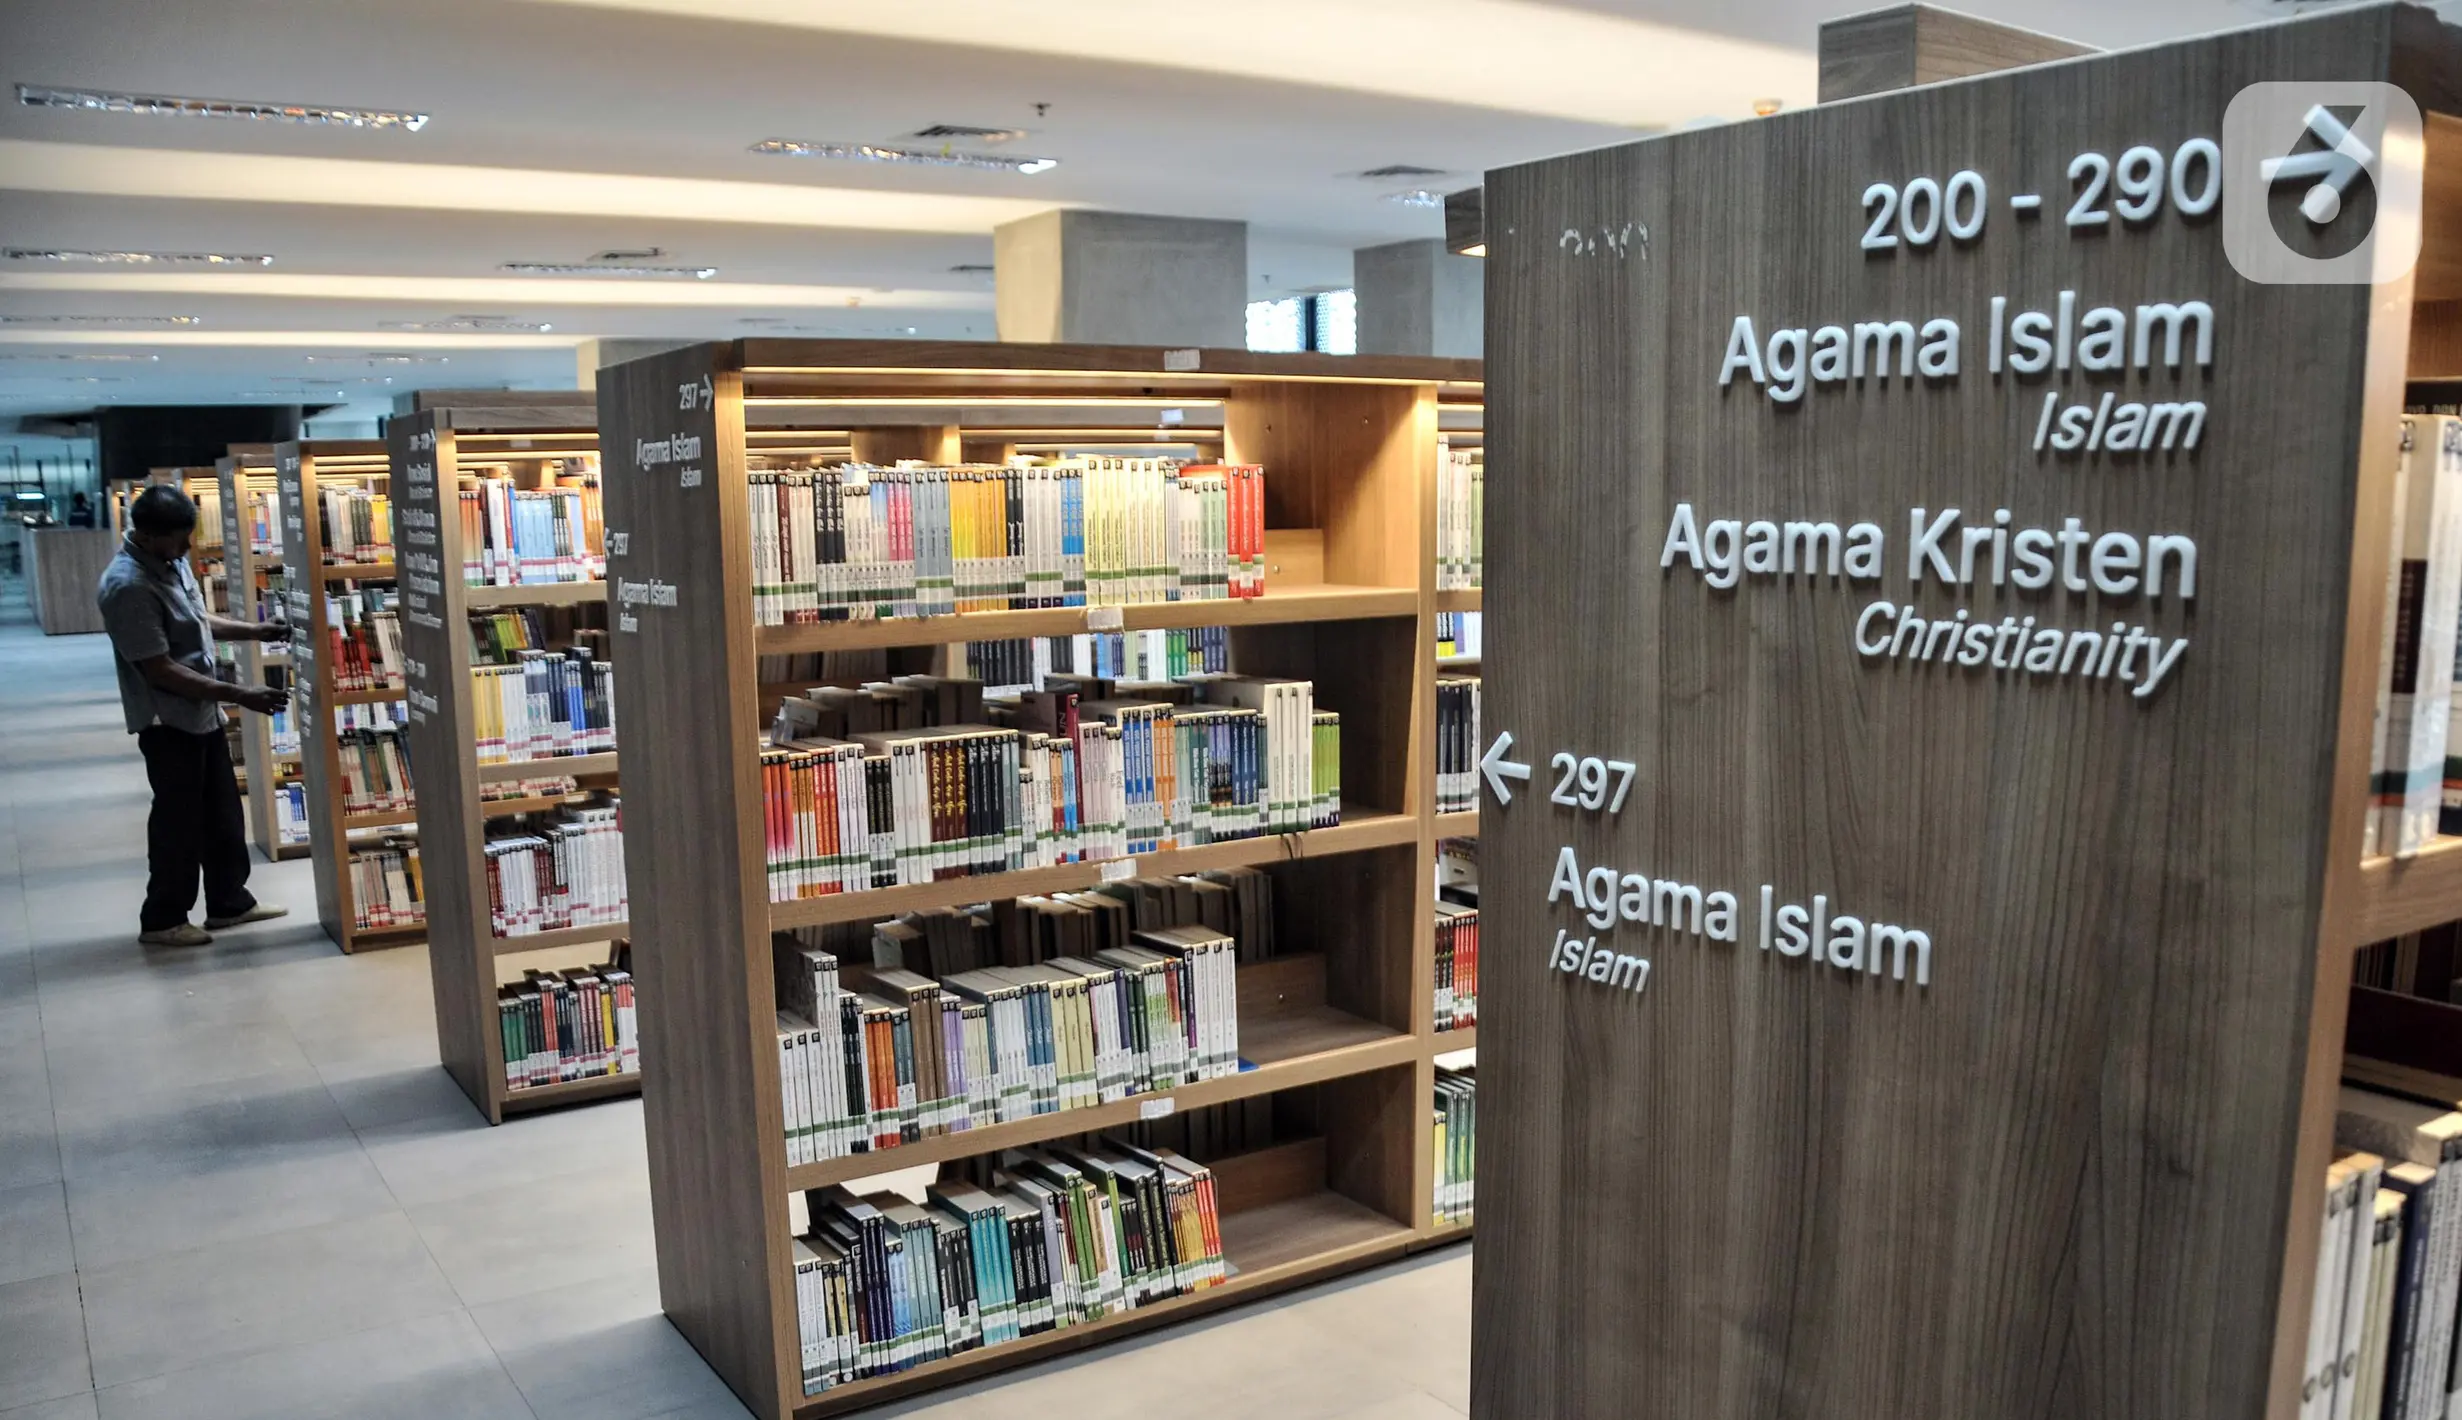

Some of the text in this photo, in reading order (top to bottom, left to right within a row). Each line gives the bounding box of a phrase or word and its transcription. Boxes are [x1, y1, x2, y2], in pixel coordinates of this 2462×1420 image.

[1860, 169, 1986, 250] 200
[2065, 137, 2222, 226] 290
[1718, 290, 2213, 402] Agama Islam
[679, 382, 698, 410] 297
[2033, 391, 2207, 451] Islam
[636, 432, 701, 471] Agama Islam
[1659, 503, 2197, 599] Agama Kristen
[1855, 600, 2189, 697] Christianity
[1550, 752, 1637, 813] 297
[1548, 846, 1931, 985] Agama Islam
[1549, 928, 1651, 992] Islam
